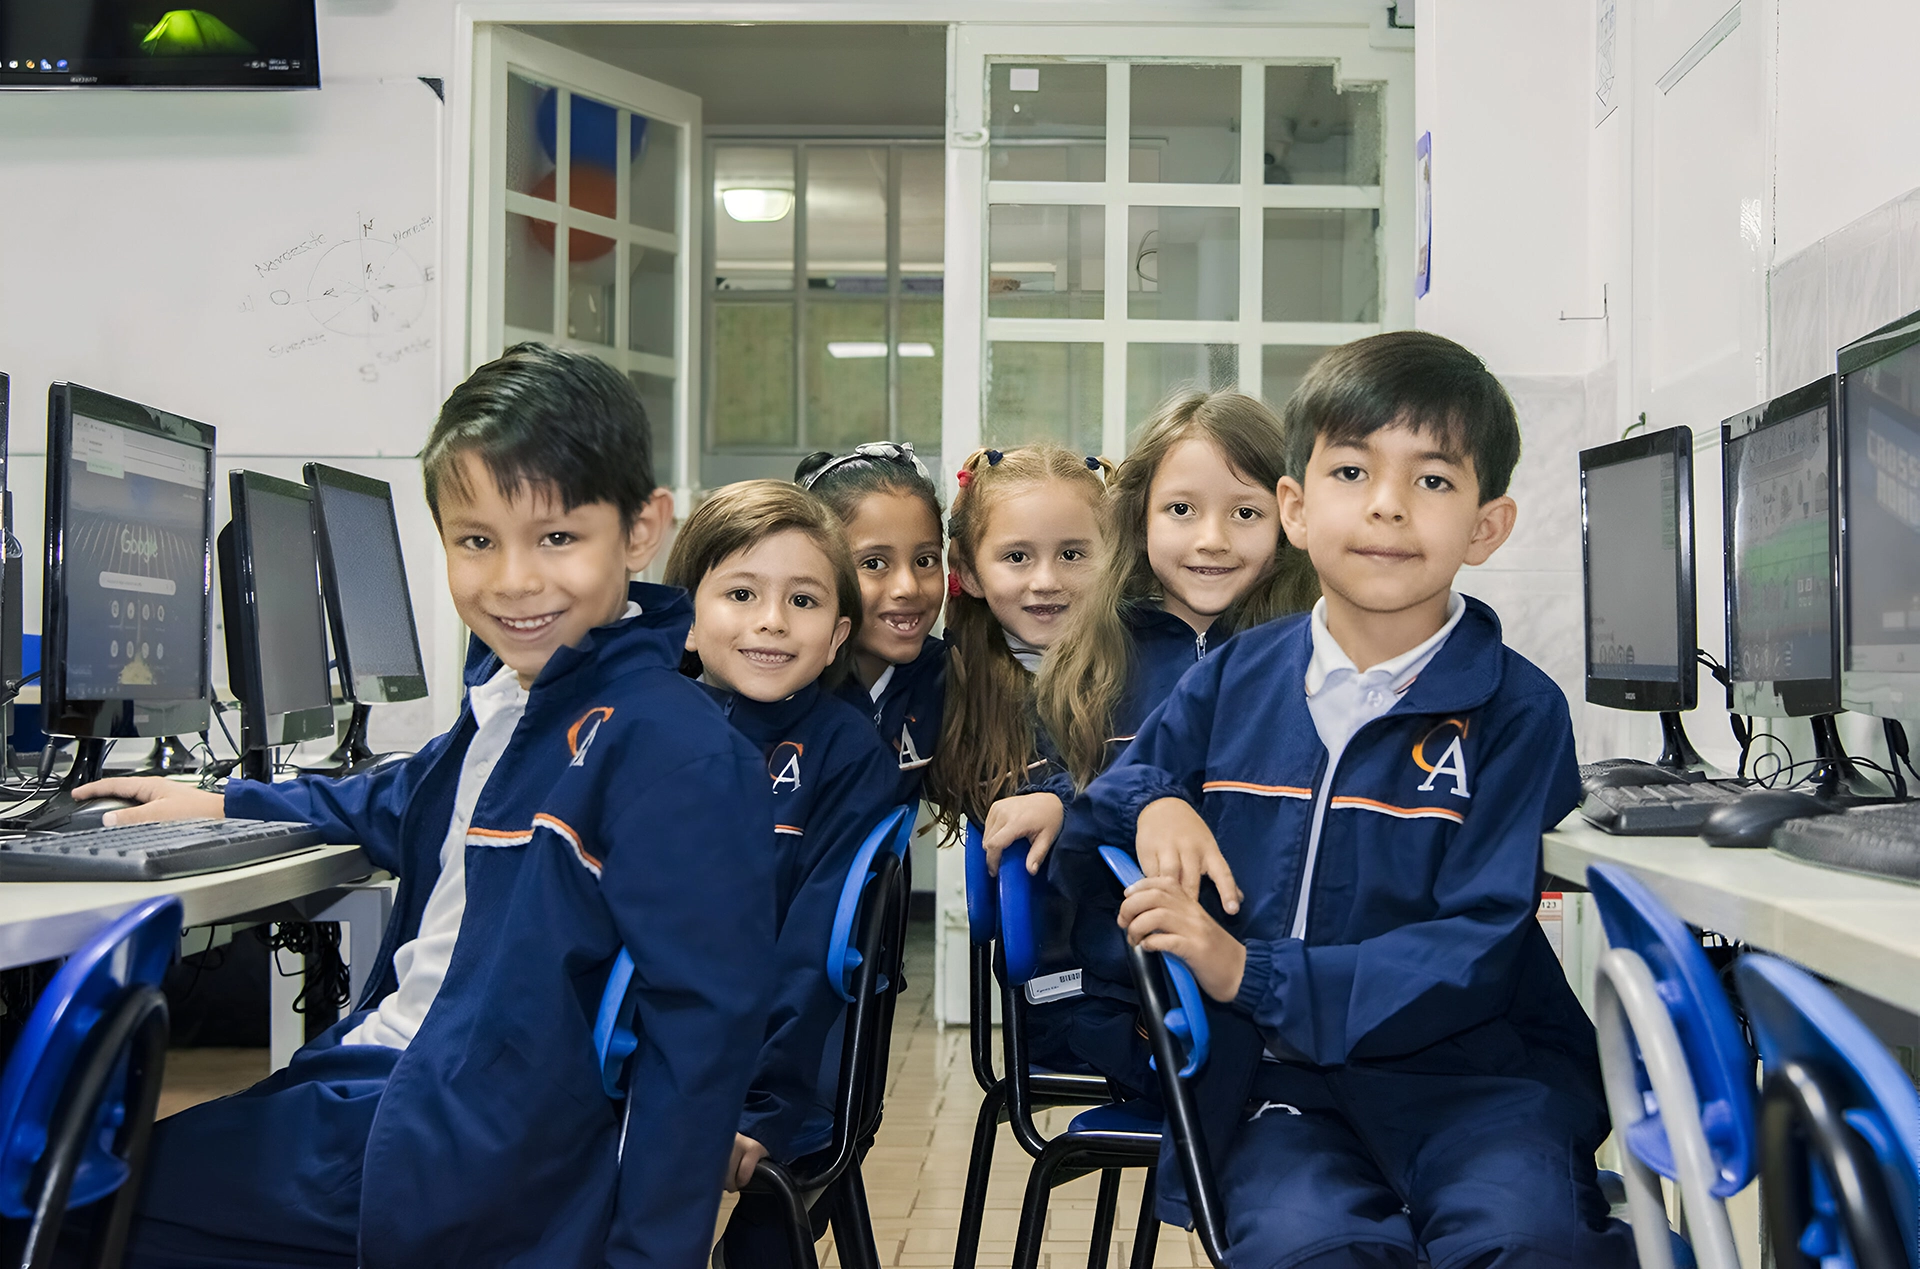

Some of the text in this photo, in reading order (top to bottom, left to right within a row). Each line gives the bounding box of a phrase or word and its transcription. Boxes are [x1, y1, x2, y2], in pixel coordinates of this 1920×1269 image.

[423, 266, 435, 282] E
[269, 289, 291, 305] O
[358, 363, 379, 382] S
[120, 525, 158, 563] Google
[567, 706, 615, 767] CA
[1411, 718, 1471, 798] CA
